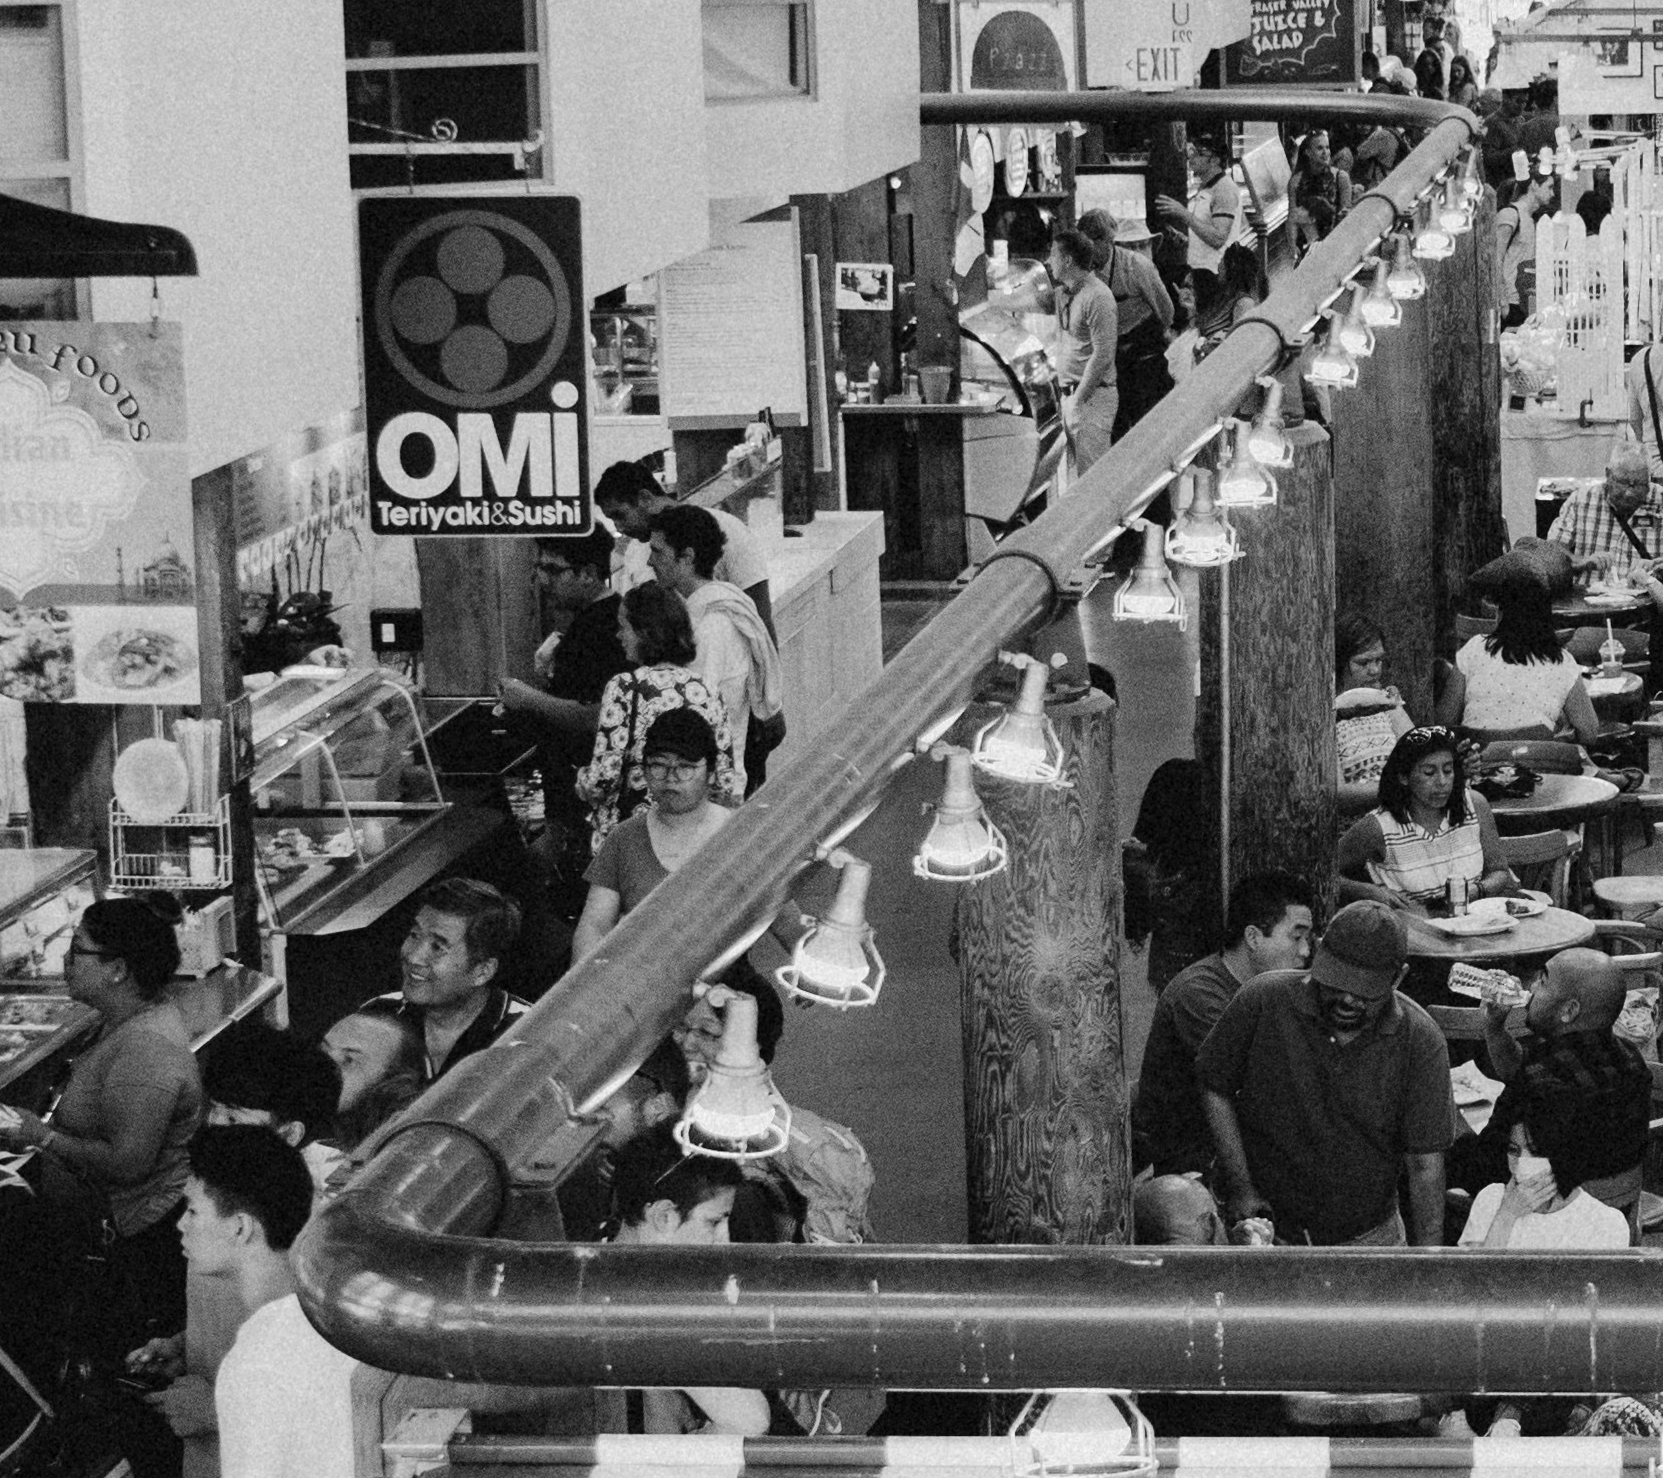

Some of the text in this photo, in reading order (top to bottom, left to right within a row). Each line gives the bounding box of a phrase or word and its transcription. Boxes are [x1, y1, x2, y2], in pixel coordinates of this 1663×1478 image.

[1250, 0, 1287, 13] FRASER
[1251, 12, 1327, 35] JUICE &
[1252, 30, 1304, 55] SALAD
[1136, 47, 1181, 83] EXIT
